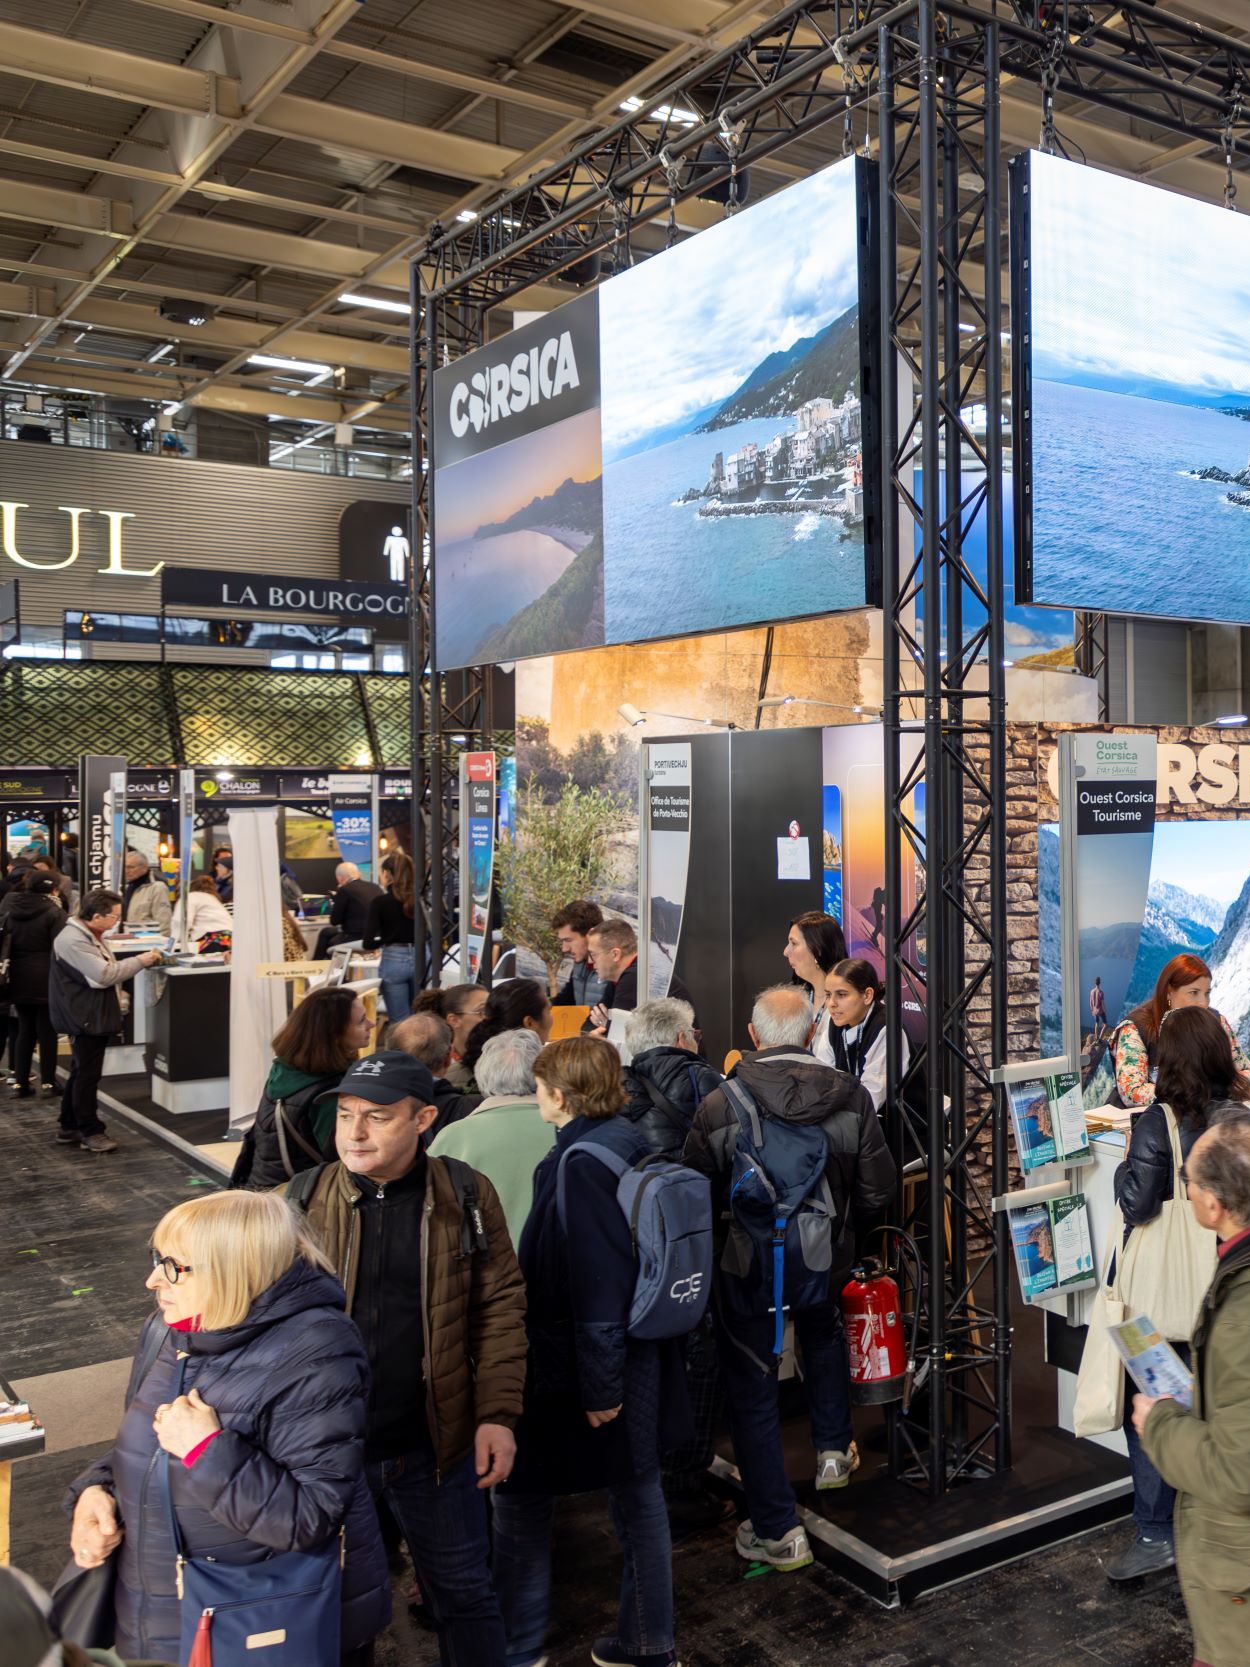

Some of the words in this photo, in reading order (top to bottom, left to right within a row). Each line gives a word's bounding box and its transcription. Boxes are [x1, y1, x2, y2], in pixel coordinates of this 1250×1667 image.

[449, 330, 580, 438] CORSICA
[222, 583, 258, 605] LA
[1096, 740, 1128, 751] Ouest
[1096, 750, 1138, 761] Corsica
[219, 781, 260, 790] CHALON
[473, 786, 490, 798] Corsica
[1080, 791, 1113, 805] Ouest
[1115, 791, 1154, 804] Corsica
[650, 795, 664, 806] Office
[670, 796, 690, 806] Tourisme
[1092, 809, 1142, 822] Tourisme
[336, 817, 371, 829] -30%
